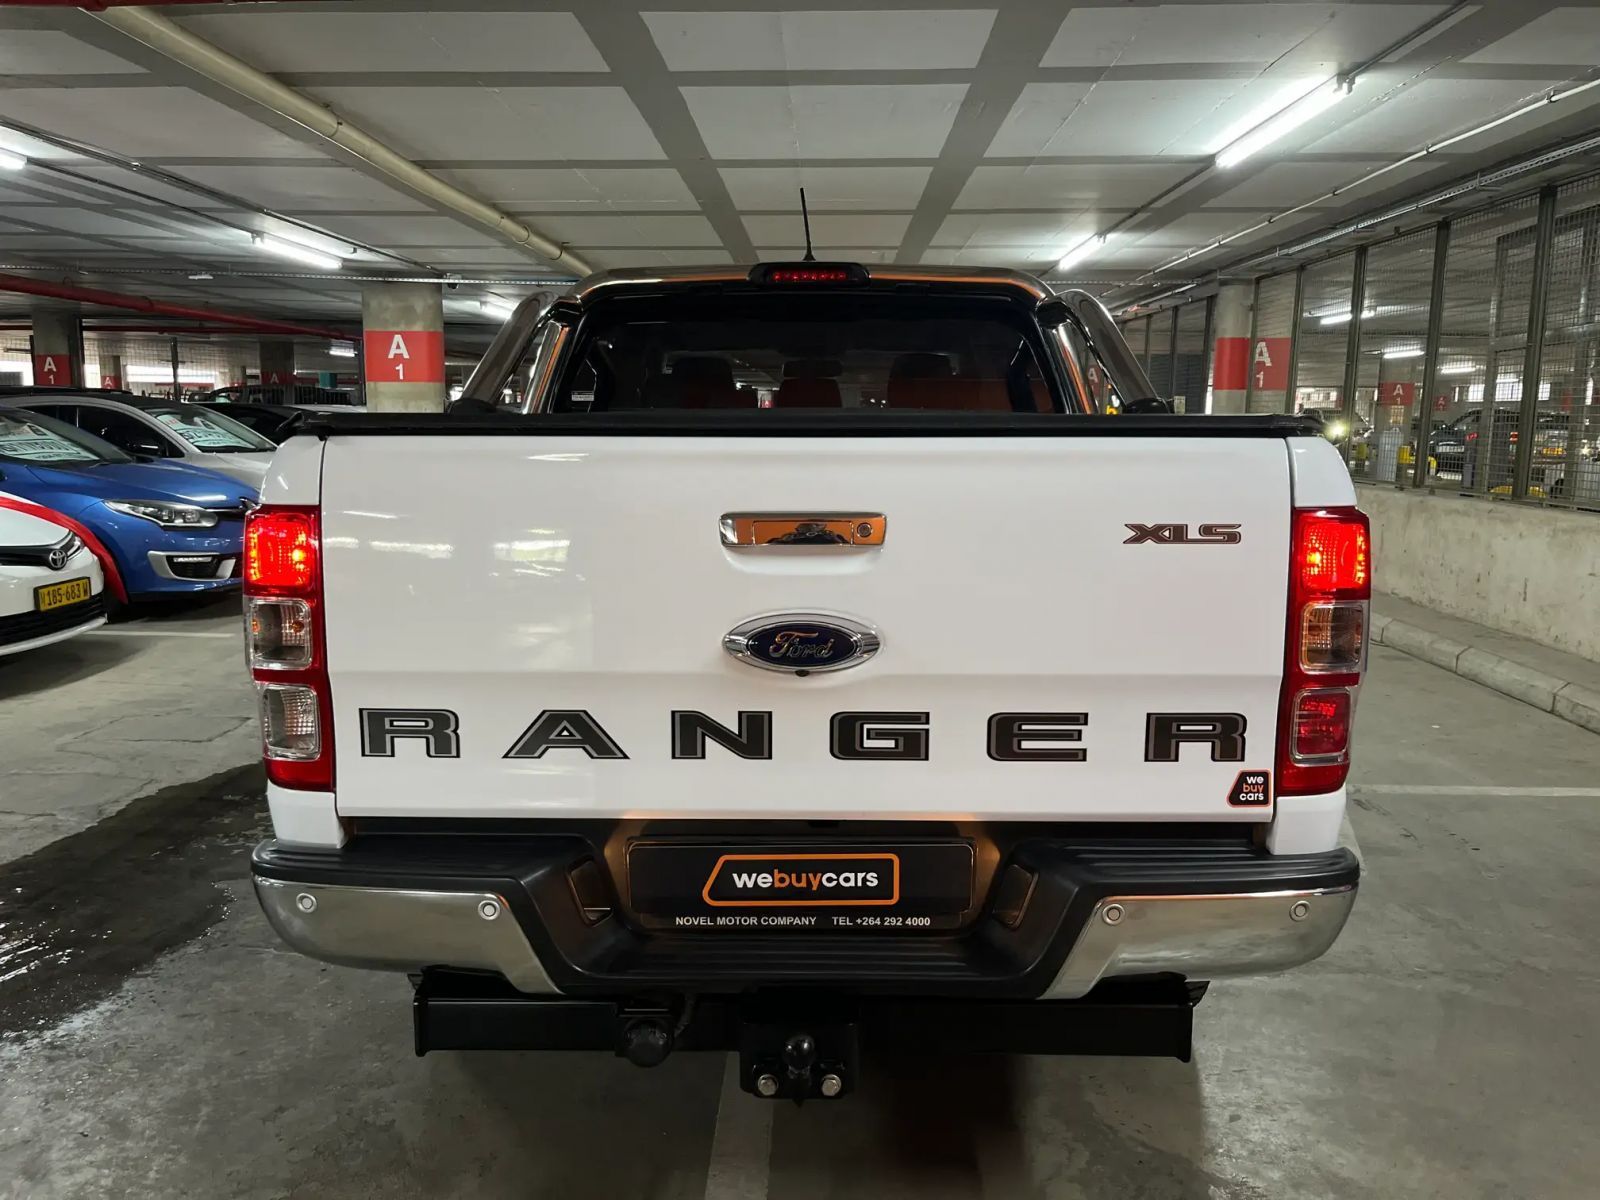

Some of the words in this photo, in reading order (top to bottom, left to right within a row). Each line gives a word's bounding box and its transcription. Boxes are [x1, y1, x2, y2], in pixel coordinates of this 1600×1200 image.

[387, 334, 410, 359] A
[1255, 341, 1273, 366] A
[43, 356, 57, 372] A
[270, 373, 280, 384] A
[395, 363, 404, 380] 1
[48, 374, 55, 385] 1
[104, 376, 113, 386] A
[1256, 371, 1265, 388] 1
[1393, 384, 1404, 396] A
[1122, 523, 1242, 545] XLS
[768, 630, 835, 658] Ford
[359, 708, 1248, 763] RANGER
[1246, 776, 1264, 784] we
[1242, 783, 1264, 793] buy
[1239, 793, 1264, 801] cars
[675, 916, 714, 926] NOVEL
[716, 916, 758, 926] MOTOR
[760, 916, 817, 926] COMPANY
[831, 916, 853, 926] TEL
[855, 916, 881, 926] +264
[883, 916, 903, 926] 292
[905, 916, 931, 926] 4000
